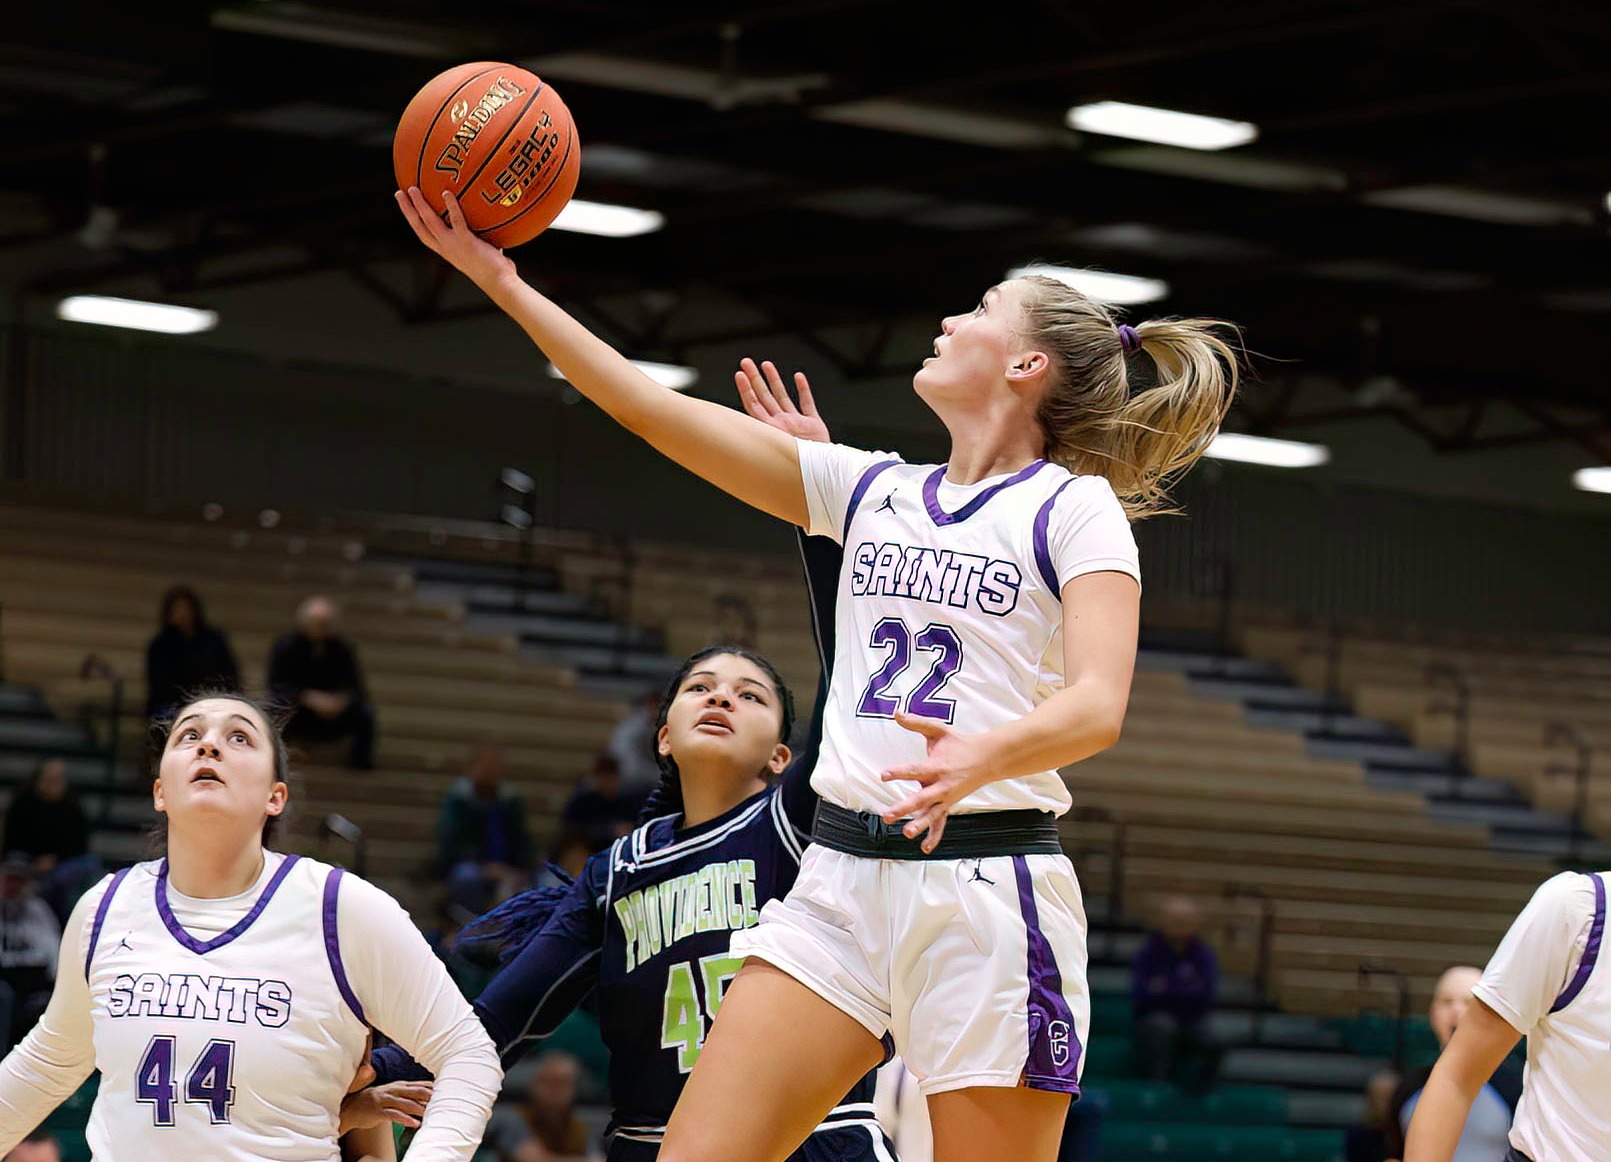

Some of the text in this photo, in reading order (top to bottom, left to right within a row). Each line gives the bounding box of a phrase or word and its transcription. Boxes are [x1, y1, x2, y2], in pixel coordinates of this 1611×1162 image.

[434, 76, 526, 183] SPALDING
[481, 110, 552, 204] LEGACY
[522, 132, 558, 187] 1000
[851, 542, 1023, 617] SAINTS
[856, 616, 963, 725] 22
[613, 859, 760, 974] PROVIDENCE
[106, 972, 292, 1028] SAINTS
[134, 1034, 237, 1127] 44
